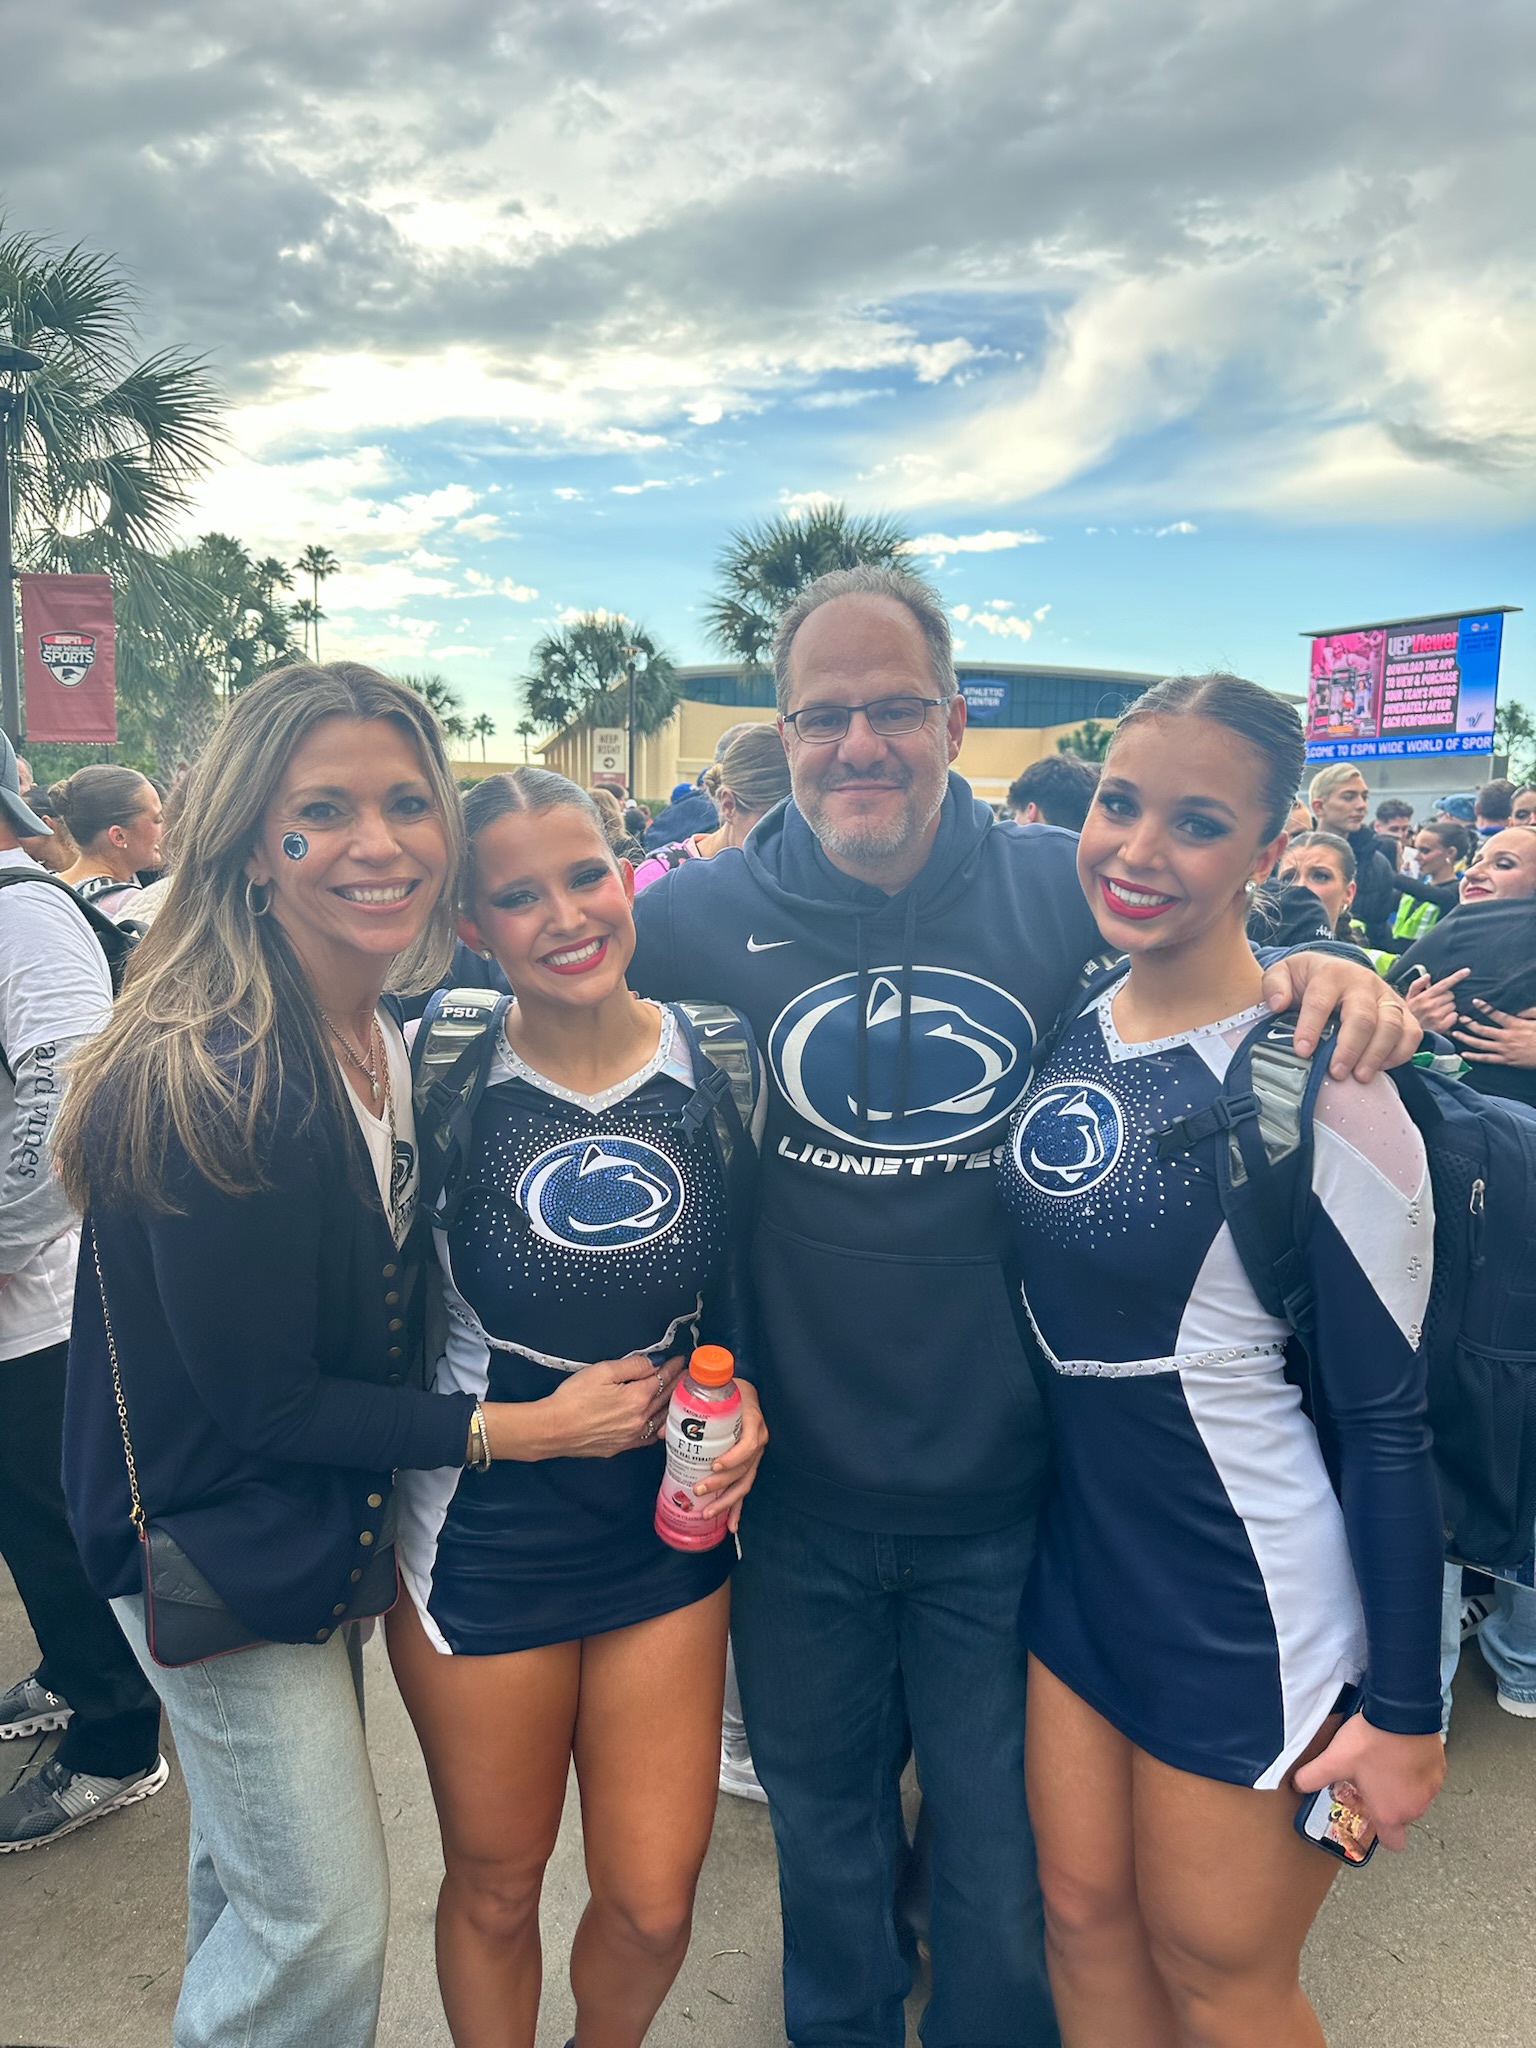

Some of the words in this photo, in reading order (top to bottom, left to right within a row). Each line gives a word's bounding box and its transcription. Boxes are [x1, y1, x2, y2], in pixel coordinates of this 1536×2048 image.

[43, 651, 94, 664] SPORTS
[1386, 661, 1424, 676] DOWNLOAD
[1425, 659, 1439, 672] THE
[1438, 657, 1455, 670] APP
[1385, 677, 1396, 689] TO
[1421, 670, 1459, 686] PURCHASE
[963, 687, 1005, 698] ATHLETIC
[1428, 684, 1457, 699] PHOTOS
[967, 697, 1001, 707] CENTER
[1427, 698, 1452, 712] AFTER
[1382, 715, 1401, 728] EACH
[599, 734, 618, 744] KEEP
[597, 745, 620, 754] RIGHT
[1337, 744, 1349, 756] TO
[1350, 742, 1376, 756] ESPN
[1378, 741, 1404, 754] WIDE
[1406, 738, 1442, 752] WORLD
[1445, 738, 1459, 751] OF
[1462, 736, 1492, 750] SPOR
[441, 1007, 479, 1018] PSU
[34, 1041, 60, 1095] ard
[678, 1439, 702, 1455] FIT
